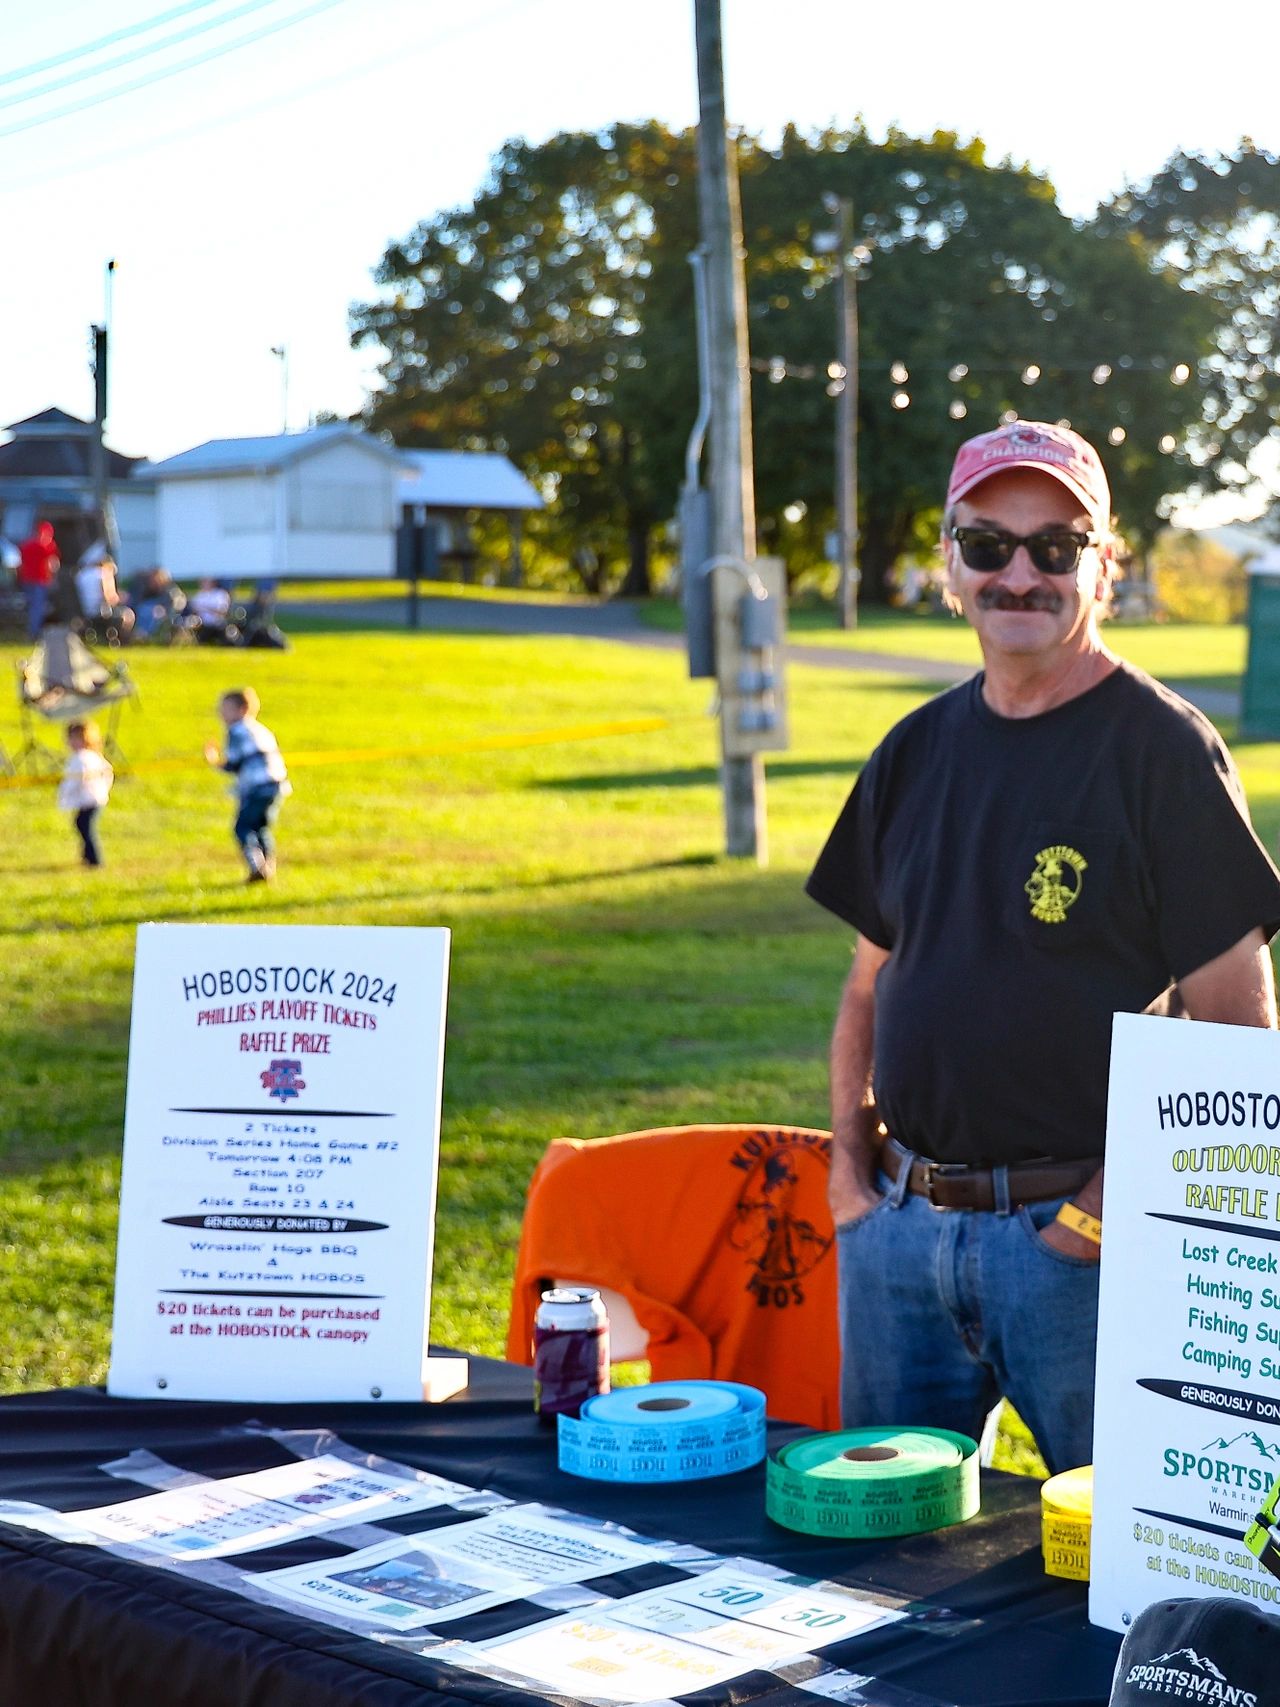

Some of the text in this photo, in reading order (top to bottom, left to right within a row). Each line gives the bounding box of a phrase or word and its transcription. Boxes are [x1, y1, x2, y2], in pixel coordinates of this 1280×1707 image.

[182, 967, 398, 1008] HOBOSTOCK 2024
[197, 999, 377, 1031] PHILLIES PLAYOFF TICKETS
[239, 1032, 332, 1054] RAFFLE PRIZE
[262, 1122, 317, 1134] Tickets
[226, 1137, 273, 1148] Series
[279, 1139, 320, 1149] Home
[328, 1140, 368, 1150] Game
[207, 1151, 280, 1163] Tomorrow
[329, 1154, 353, 1165] PM
[232, 1167, 289, 1178] Section
[249, 1182, 279, 1193] Row
[1186, 1183, 1269, 1220] RAFFLE
[203, 1216, 348, 1231] GENEROUSLY DONATED BY
[272, 1244, 312, 1255] Hogs
[321, 1245, 358, 1256] BBQ
[1182, 1238, 1220, 1265] Lost
[1226, 1247, 1279, 1275] Creek
[180, 1268, 366, 1283] The Kutztown HOBOS
[1187, 1273, 1253, 1310] Hunting
[157, 1301, 381, 1321] $20 tickets can be purchased
[169, 1323, 369, 1343] at the HOBOSTOCK canopy
[1188, 1307, 1249, 1344] Fishing
[1181, 1341, 1252, 1379] Camping
[1180, 1385, 1253, 1413] GENEROUSLY
[631, 1457, 665, 1472] TICKET
[1211, 1485, 1265, 1506] WAREHO
[816, 1510, 849, 1526] TICKET
[864, 1510, 901, 1527] TICKET
[1208, 1500, 1255, 1524] Warmins
[1133, 1522, 1164, 1546] $20
[1168, 1533, 1220, 1562] tickets
[1224, 1551, 1253, 1571] can
[1052, 1551, 1085, 1569] TICKET
[1146, 1555, 1162, 1572] at
[1166, 1558, 1190, 1580] the
[698, 1585, 764, 1606] 50
[780, 1608, 847, 1628] 50
[1125, 1664, 1258, 1707] SPORTSMAN'S
[1138, 1680, 1227, 1707] WAREHOUSE
